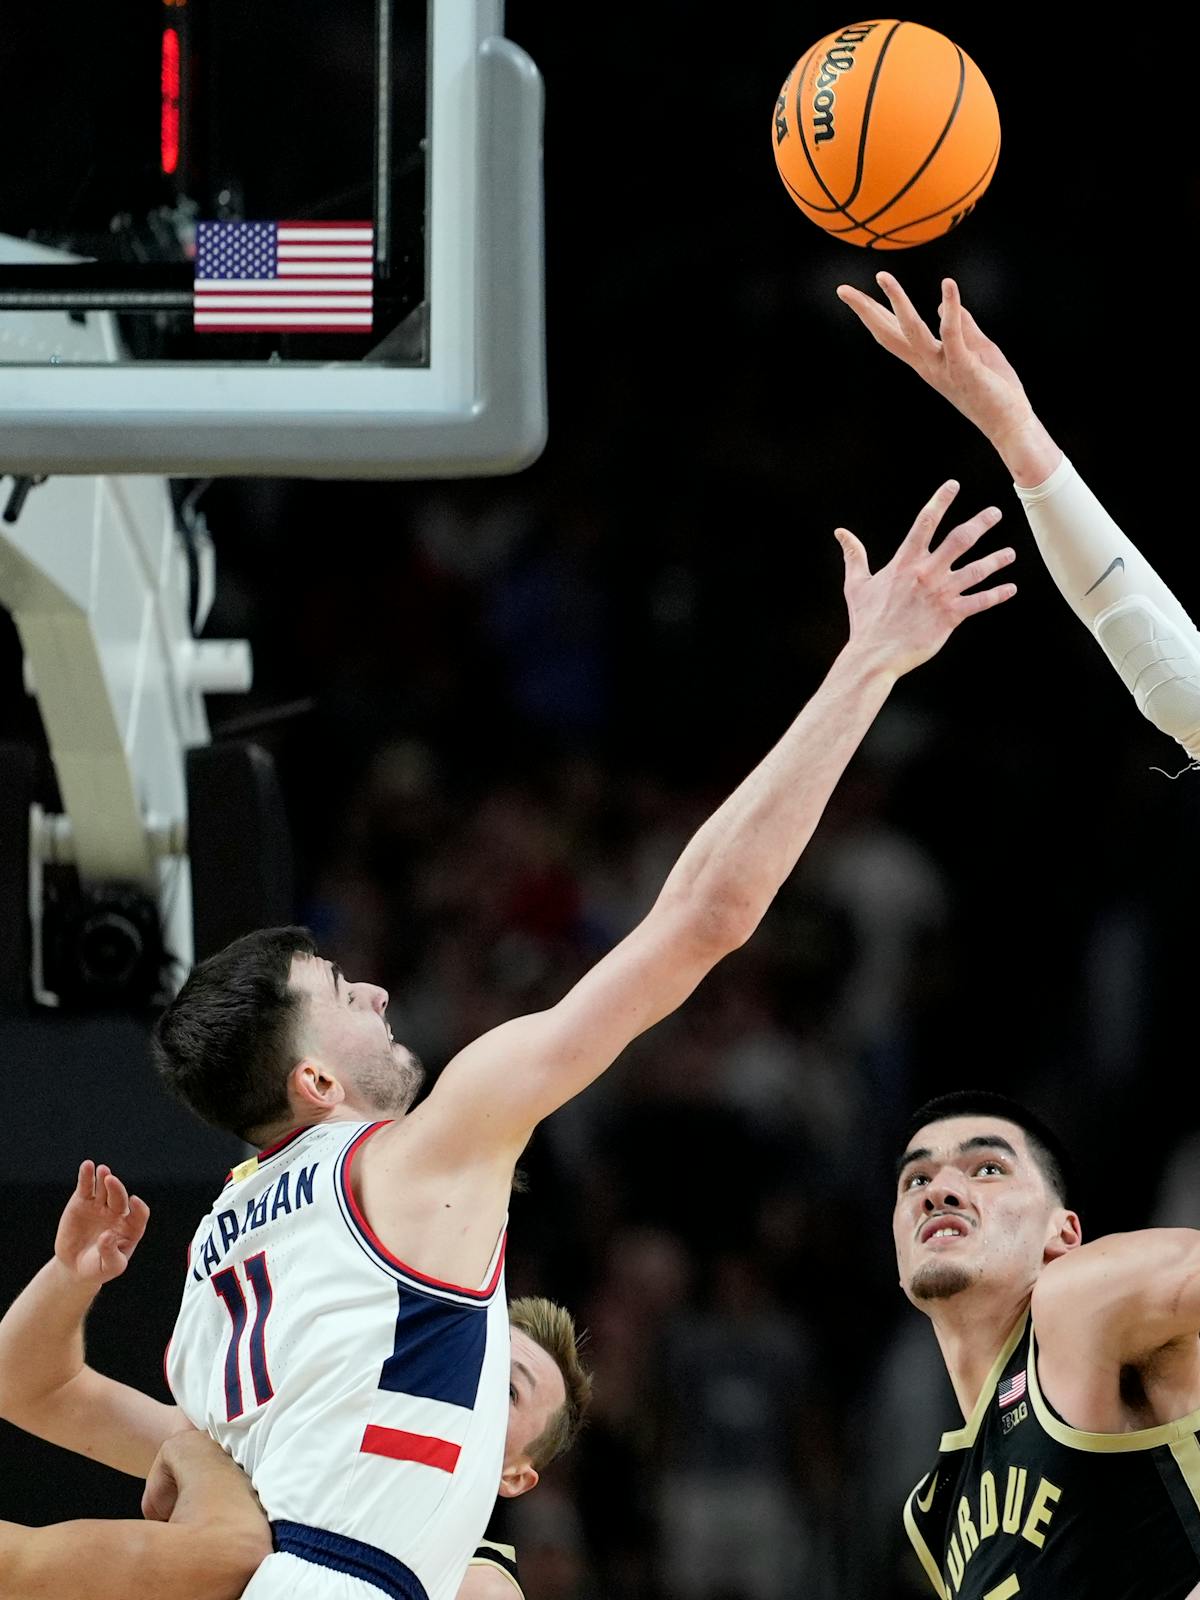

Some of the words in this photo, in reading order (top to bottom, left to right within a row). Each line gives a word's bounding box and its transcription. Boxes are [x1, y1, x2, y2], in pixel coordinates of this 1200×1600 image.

[811, 23, 880, 145] Wilson
[210, 1251, 274, 1422] 11
[945, 1466, 1063, 1600] URDUE
